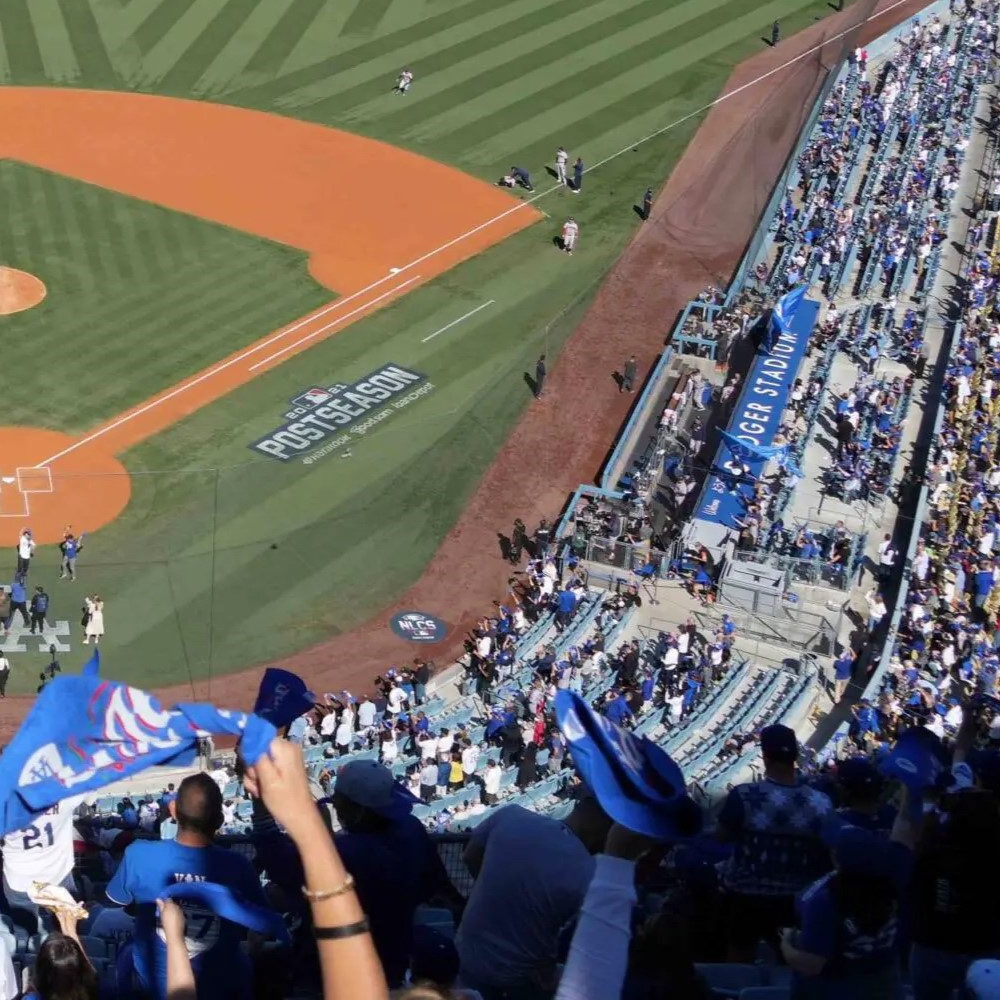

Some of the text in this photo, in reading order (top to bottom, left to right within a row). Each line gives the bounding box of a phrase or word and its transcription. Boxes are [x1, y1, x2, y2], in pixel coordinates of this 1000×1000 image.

[328, 383, 347, 395] 21
[256, 366, 420, 460] POSTSEASON
[285, 407, 307, 420] 20
[397, 620, 437, 631] NLCS
[20, 822, 54, 850] 21
